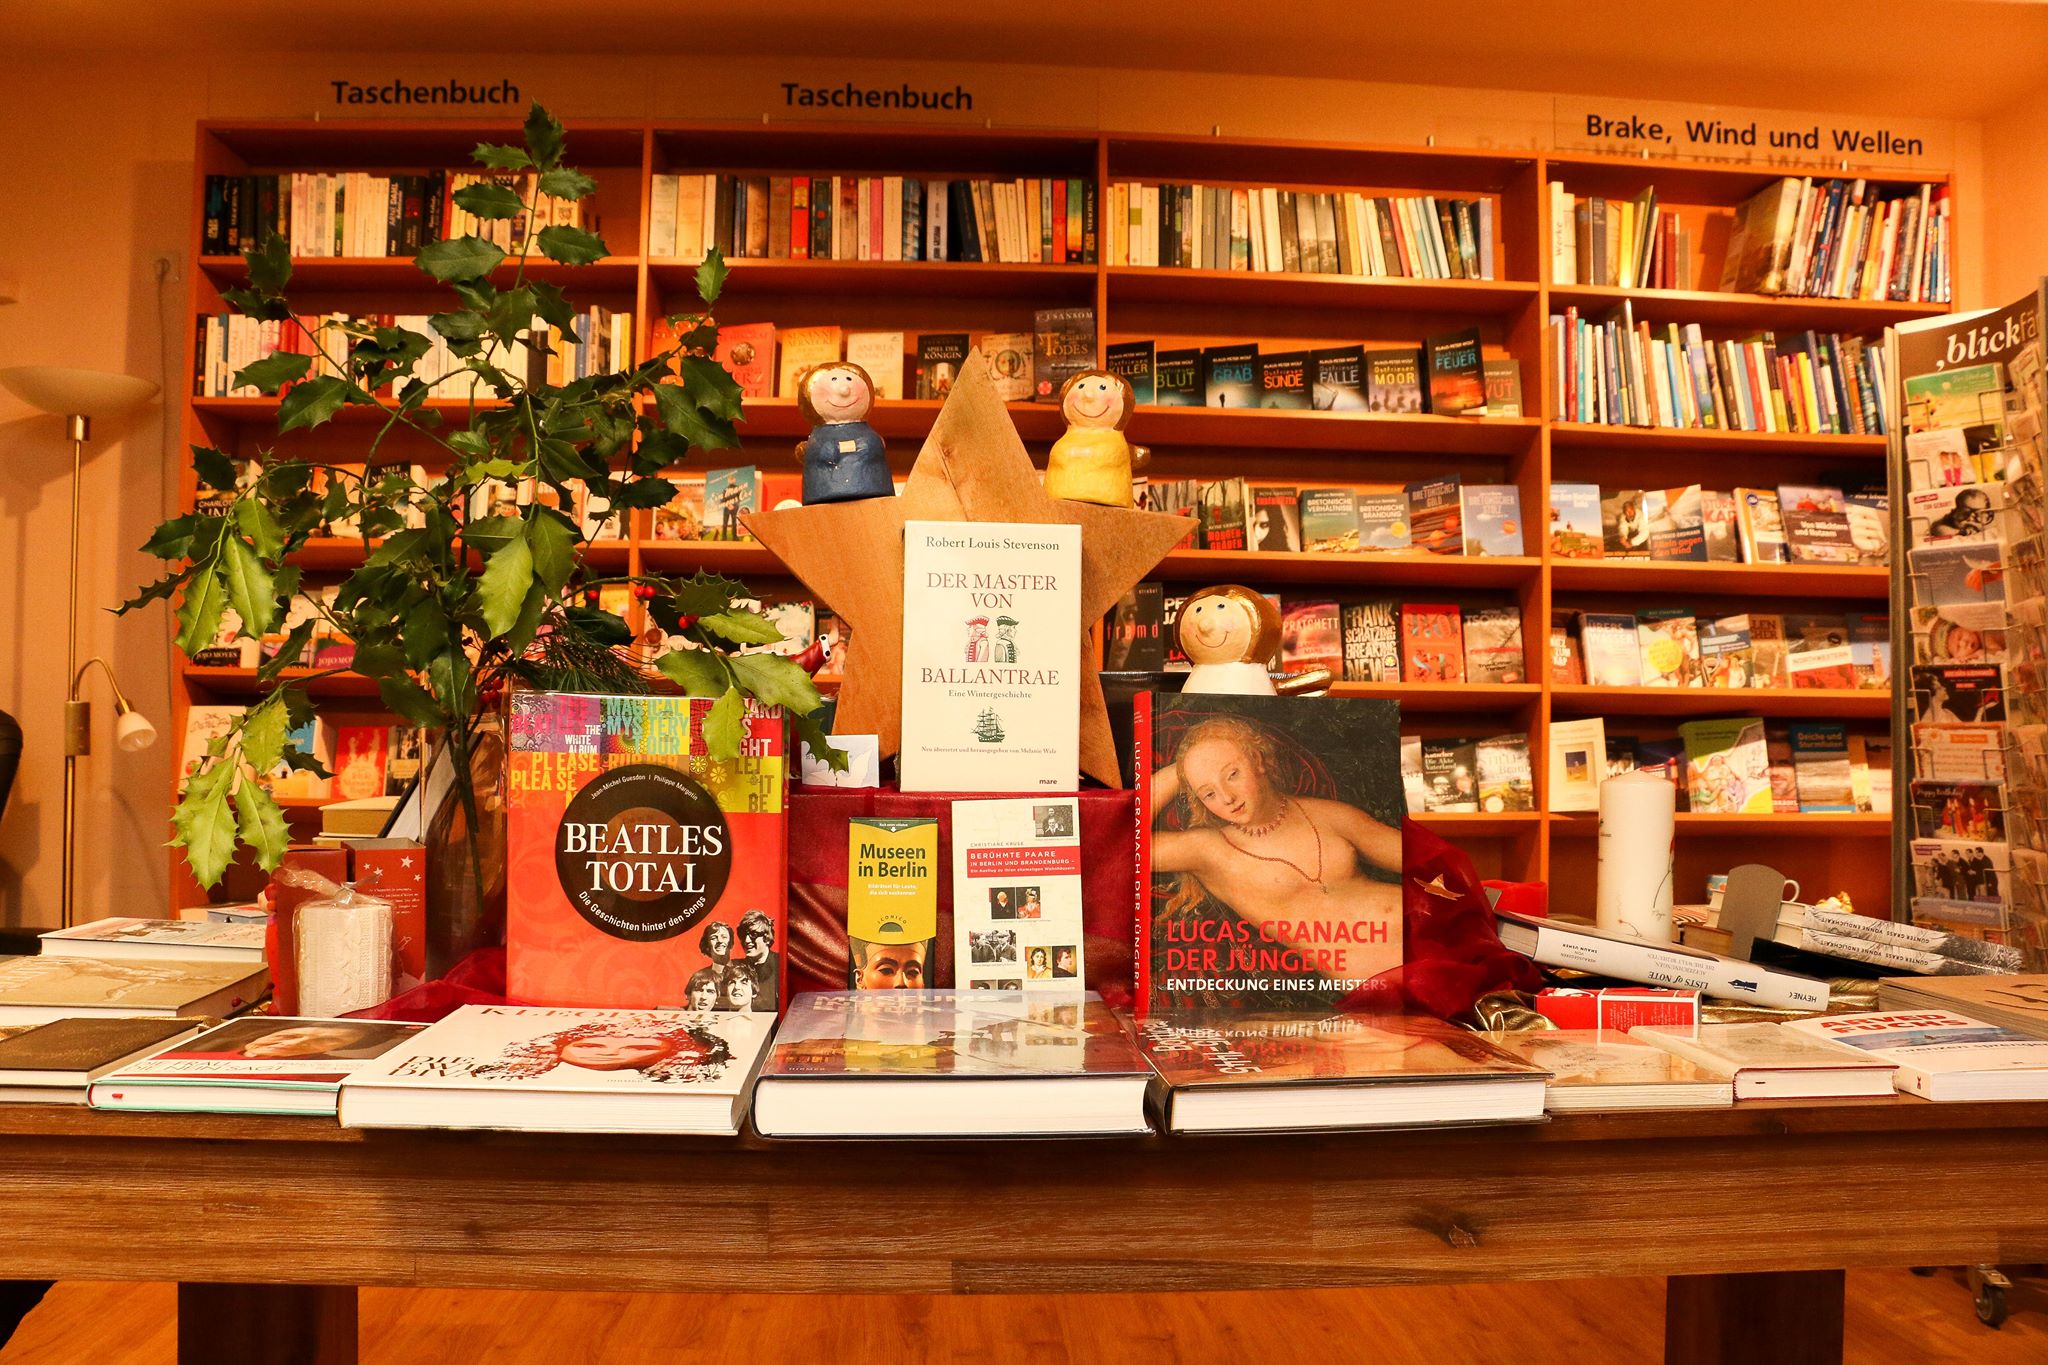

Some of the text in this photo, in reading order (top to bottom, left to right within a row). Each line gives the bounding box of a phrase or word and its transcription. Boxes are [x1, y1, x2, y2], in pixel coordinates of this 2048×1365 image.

[331, 79, 519, 105] Taschenbuch
[782, 83, 973, 110] Taschenbuch
[1587, 114, 1922, 156] Brake, Wind und Wellen
[1436, 353, 1476, 370] FEUER
[1157, 372, 1194, 388] BLUT
[1213, 367, 1252, 383] GRAB
[1375, 373, 1415, 385] MOOR
[1307, 498, 1352, 506] BRETONISCHE
[1359, 504, 1404, 513] BRETONISCHE
[1363, 511, 1402, 519] BRANDUNG
[926, 536, 1060, 550] Robert Louis Stevenson
[927, 572, 1058, 591] DER MASTER
[971, 593, 1013, 609] VON
[1345, 603, 1395, 627] FRANK
[1345, 641, 1397, 660] BREAKING
[318, 657, 338, 665] JOJO
[921, 667, 1060, 686] BALLANTRAE
[1347, 659, 1385, 682] NEW
[948, 689, 1033, 700] Eine Wintergeschichte
[585, 724, 601, 735] THE
[564, 734, 592, 745] WHITE
[569, 744, 598, 754] ALBUM
[591, 778, 622, 800] Jean-Michel
[622, 774, 646, 783] Guesdon
[653, 774, 676, 786] Philippe
[675, 782, 698, 801] Margotin
[748, 794, 768, 812] BE
[563, 822, 722, 856] BEATLES
[860, 843, 926, 859] Museen
[970, 850, 1057, 860] BERÜHMTE PAARE
[858, 861, 928, 877] in Berlin
[1133, 741, 1142, 990] LUCAS CRANACH DER JÜNGERE
[585, 861, 706, 893] TOTAL
[578, 890, 707, 932] Die Geschichten hinter den Songs
[1167, 920, 1388, 944] LUCAS CRANACH
[1863, 926, 1882, 934] VONNE
[1886, 930, 1905, 939] GRASS
[1167, 944, 1348, 972] DER JÜNGERE
[1861, 949, 1882, 957] VONNE
[1885, 953, 1904, 962] GRASS
[1167, 979, 1388, 992] ENTDECKUNG EINES MEISTERS
[1647, 970, 1709, 990] LISTS of NOTE
[1820, 1013, 1948, 1029] ARVED
[1830, 1019, 1969, 1034] FUCHS
